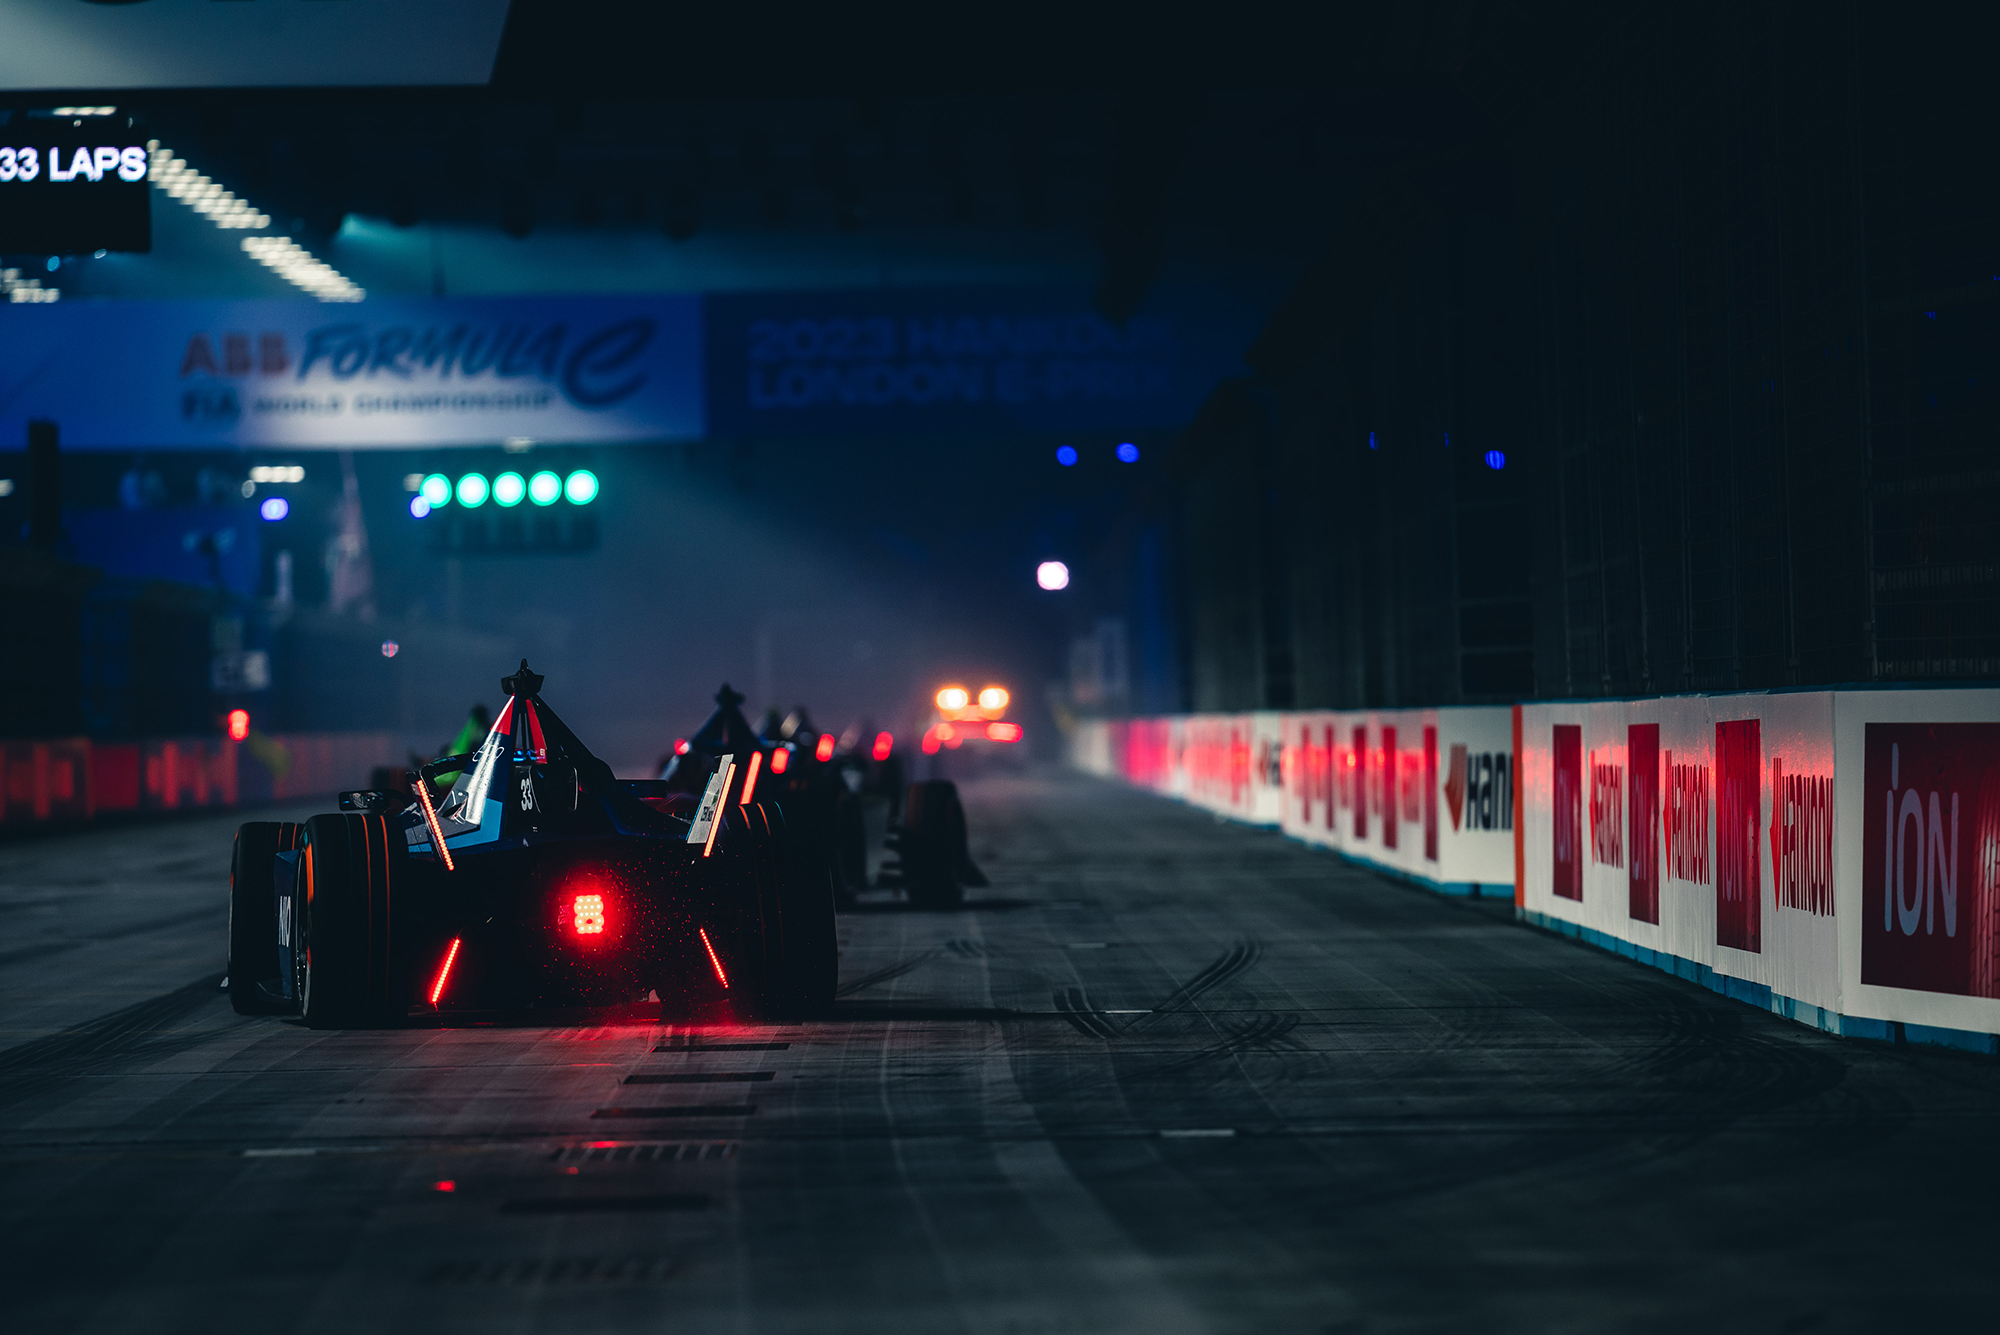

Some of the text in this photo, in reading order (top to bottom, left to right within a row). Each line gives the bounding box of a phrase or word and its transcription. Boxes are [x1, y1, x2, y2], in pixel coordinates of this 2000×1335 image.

[0, 146, 147, 182] 33 LAPS
[180, 332, 289, 378] ABB
[299, 320, 567, 382] FORMULA
[747, 361, 982, 408] LONDON
[180, 388, 551, 421] FIA WORLD CHAMPIONSHIP
[521, 778, 533, 811] 33
